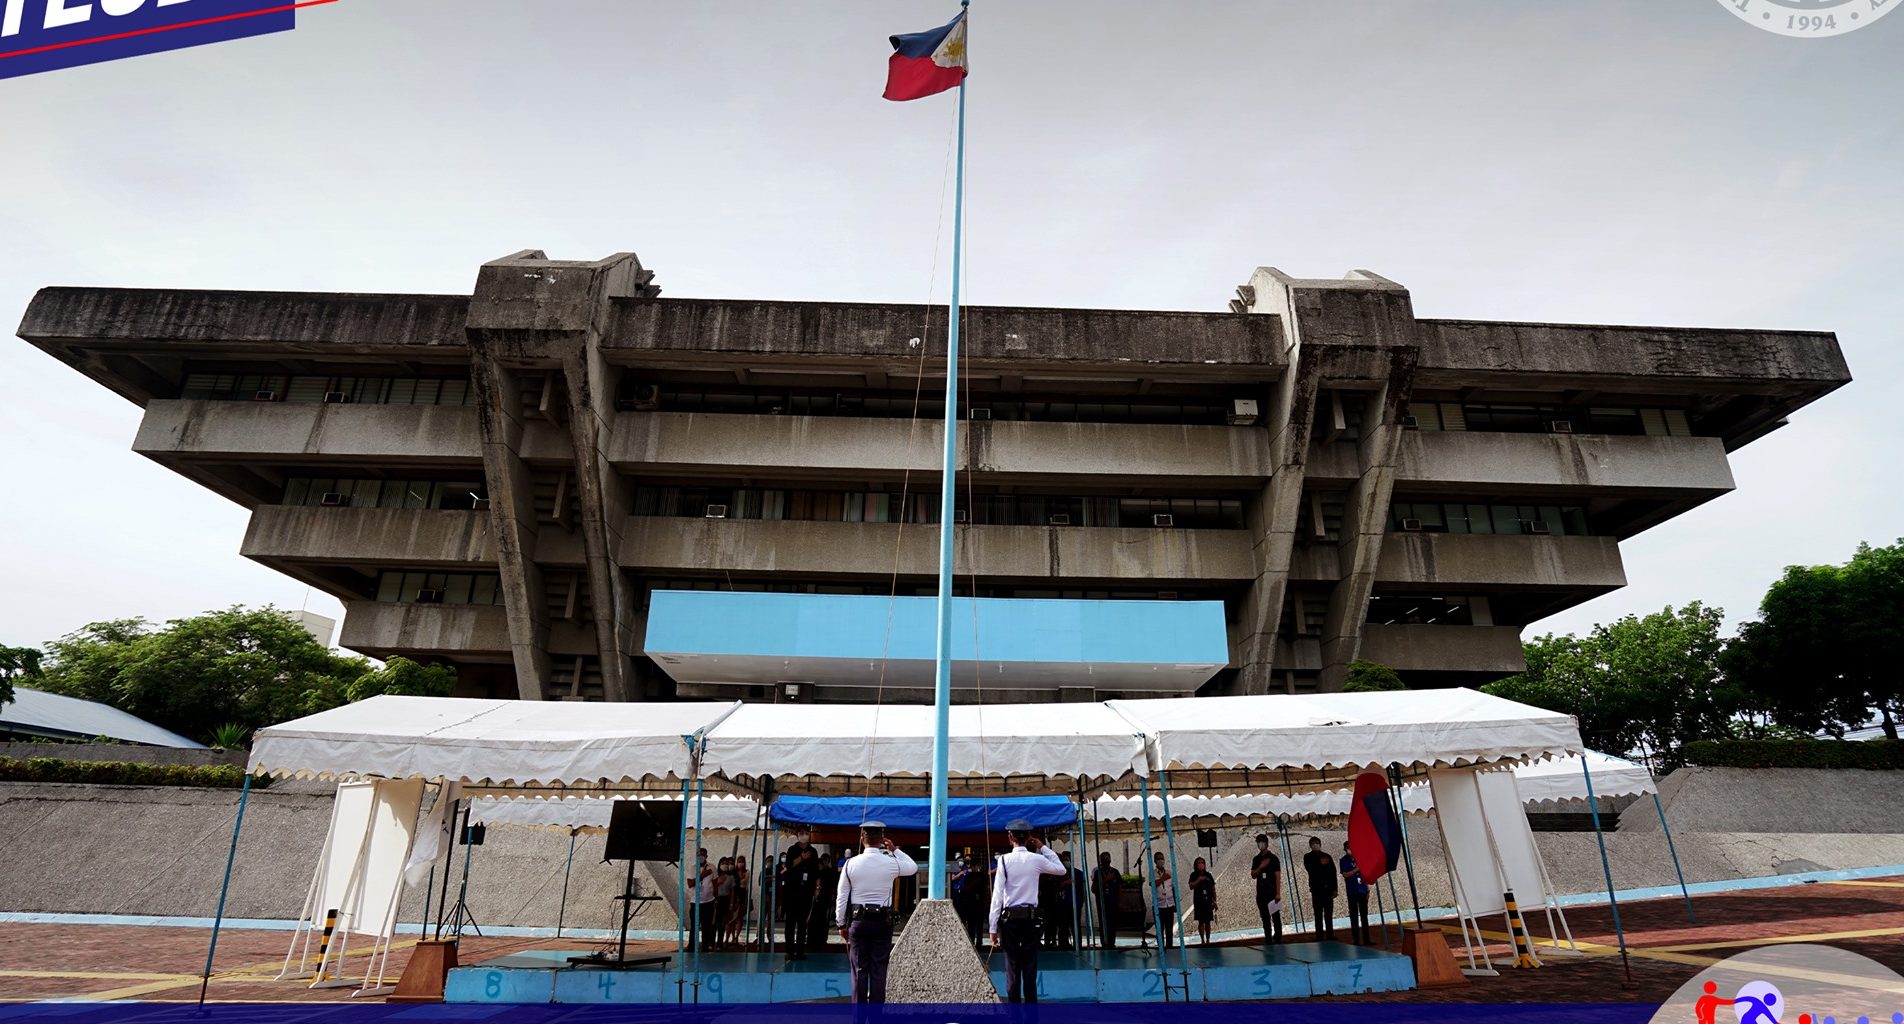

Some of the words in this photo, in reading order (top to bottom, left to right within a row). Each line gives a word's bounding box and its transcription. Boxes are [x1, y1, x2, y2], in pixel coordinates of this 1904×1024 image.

[485, 971, 503, 999] 8
[598, 972, 616, 1000] 4
[706, 973, 723, 1003] 9
[824, 978, 842, 998] 5
[1142, 971, 1165, 997] 2
[1251, 968, 1273, 996] 3
[1348, 963, 1363, 988] 7
